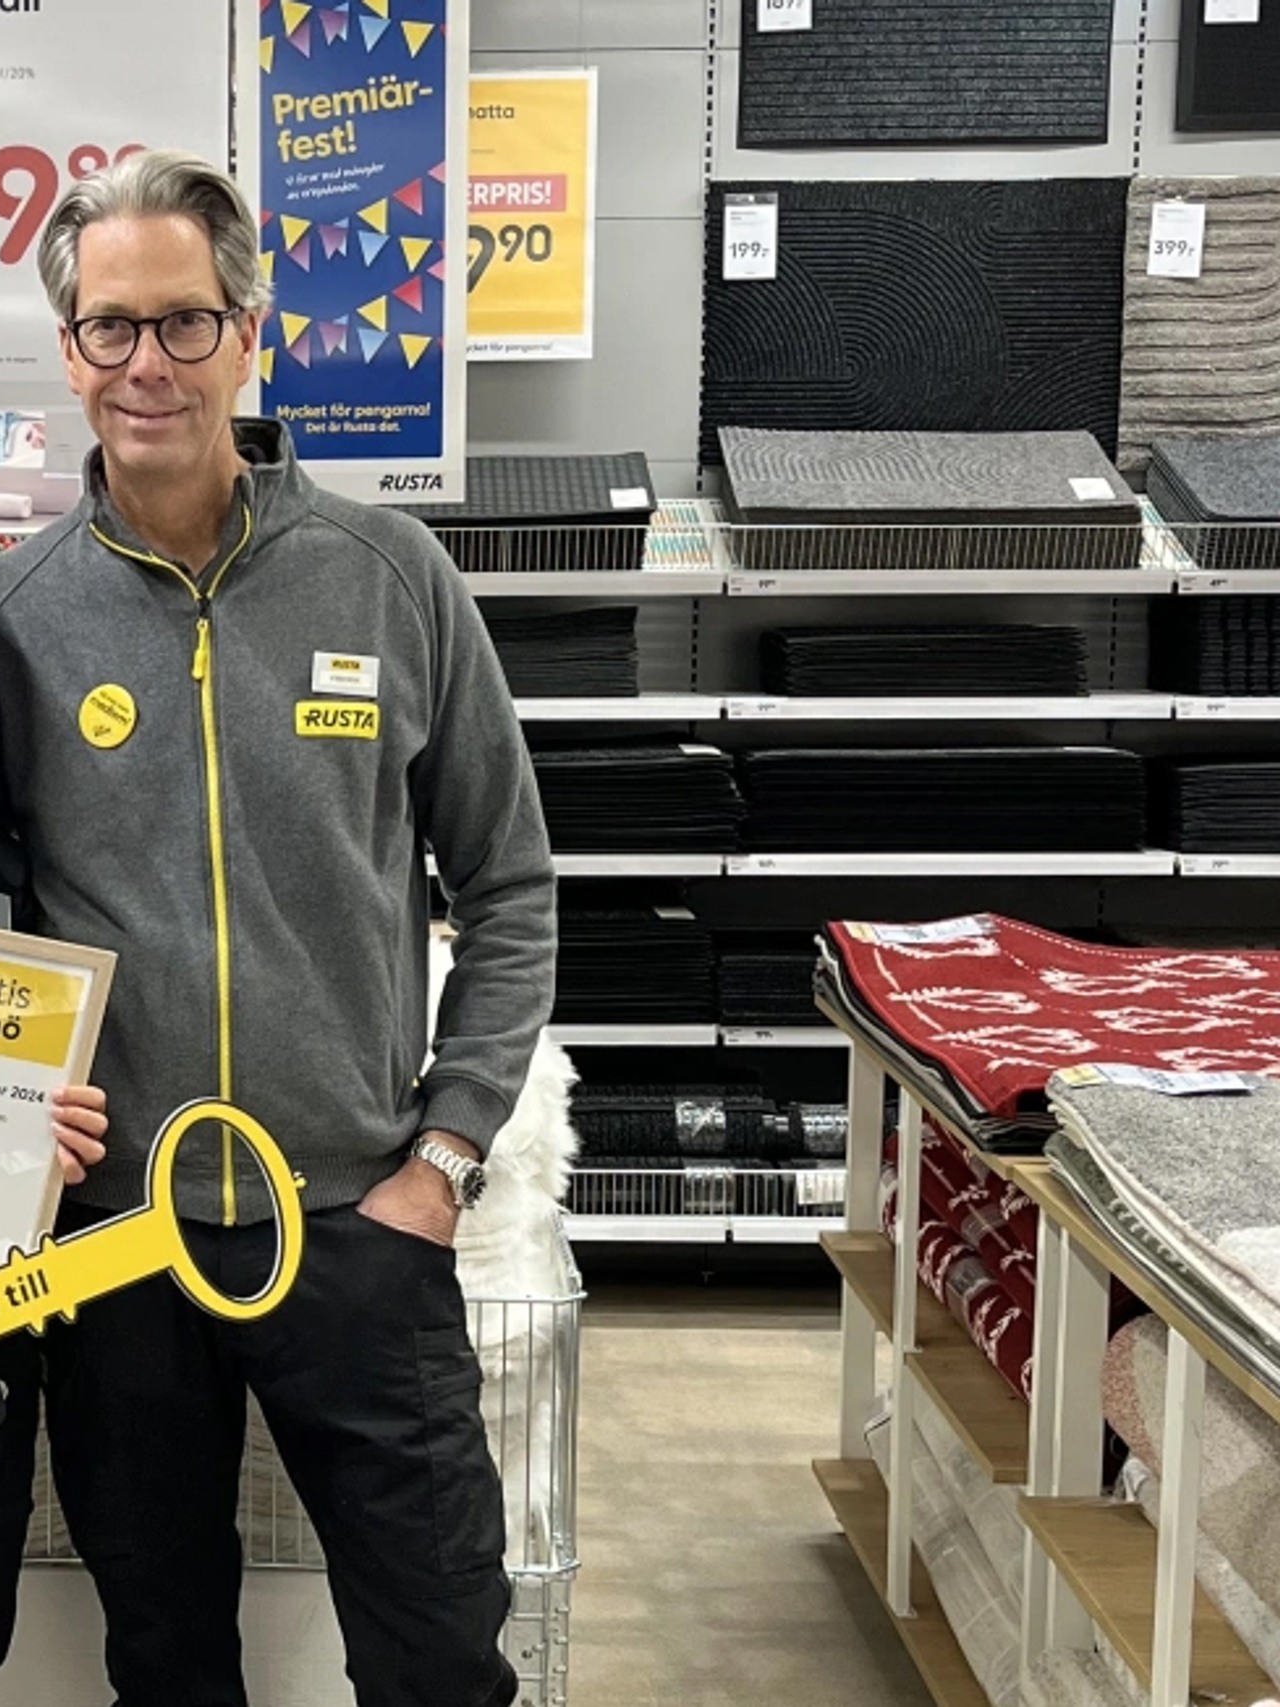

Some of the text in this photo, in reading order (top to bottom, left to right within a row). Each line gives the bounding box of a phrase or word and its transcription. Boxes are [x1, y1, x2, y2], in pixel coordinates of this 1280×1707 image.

[272, 74, 433, 125] Premiär-
[277, 120, 357, 163] fest!
[277, 402, 431, 420] Mycket för pengarna!
[305, 422, 326, 433] Det
[328, 422, 342, 432] är
[343, 422, 376, 432] Rusta
[379, 474, 444, 491] RUSTA
[304, 709, 374, 730] RUSTA
[10, 1084, 46, 1103] 2024
[5, 1269, 50, 1307] till
